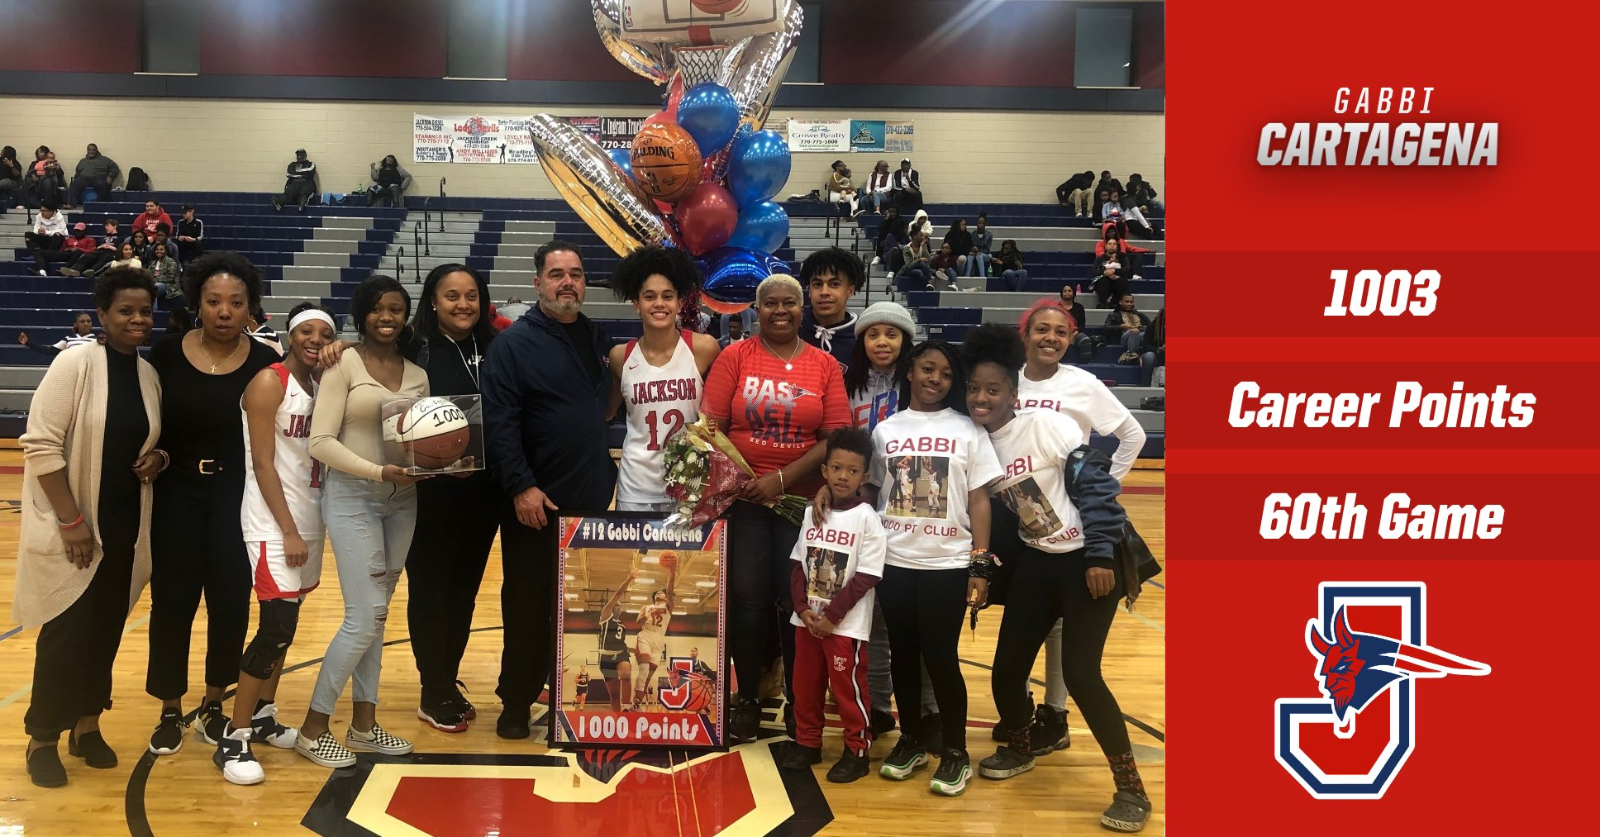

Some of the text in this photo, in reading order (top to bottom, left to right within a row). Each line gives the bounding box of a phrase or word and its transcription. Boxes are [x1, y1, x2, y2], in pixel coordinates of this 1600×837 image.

[454, 123, 500, 135] Lady Devils
[607, 119, 627, 137] Ingram
[631, 145, 675, 162] PALDING
[630, 378, 697, 405] JACKSON
[743, 376, 793, 401] BAS
[1012, 399, 1061, 412] ABBI
[433, 408, 465, 427] 1000
[645, 409, 685, 451] 12
[749, 437, 767, 446] RED
[885, 436, 957, 455] GABBI
[583, 522, 703, 547] #12 Gabbi Cartagena
[805, 528, 856, 547] GABBI
[904, 523, 918, 534] PT
[923, 525, 958, 537] CLUB
[1047, 527, 1080, 544] CLUB
[615, 626, 623, 640] 3
[578, 715, 699, 741] 1000 Points
